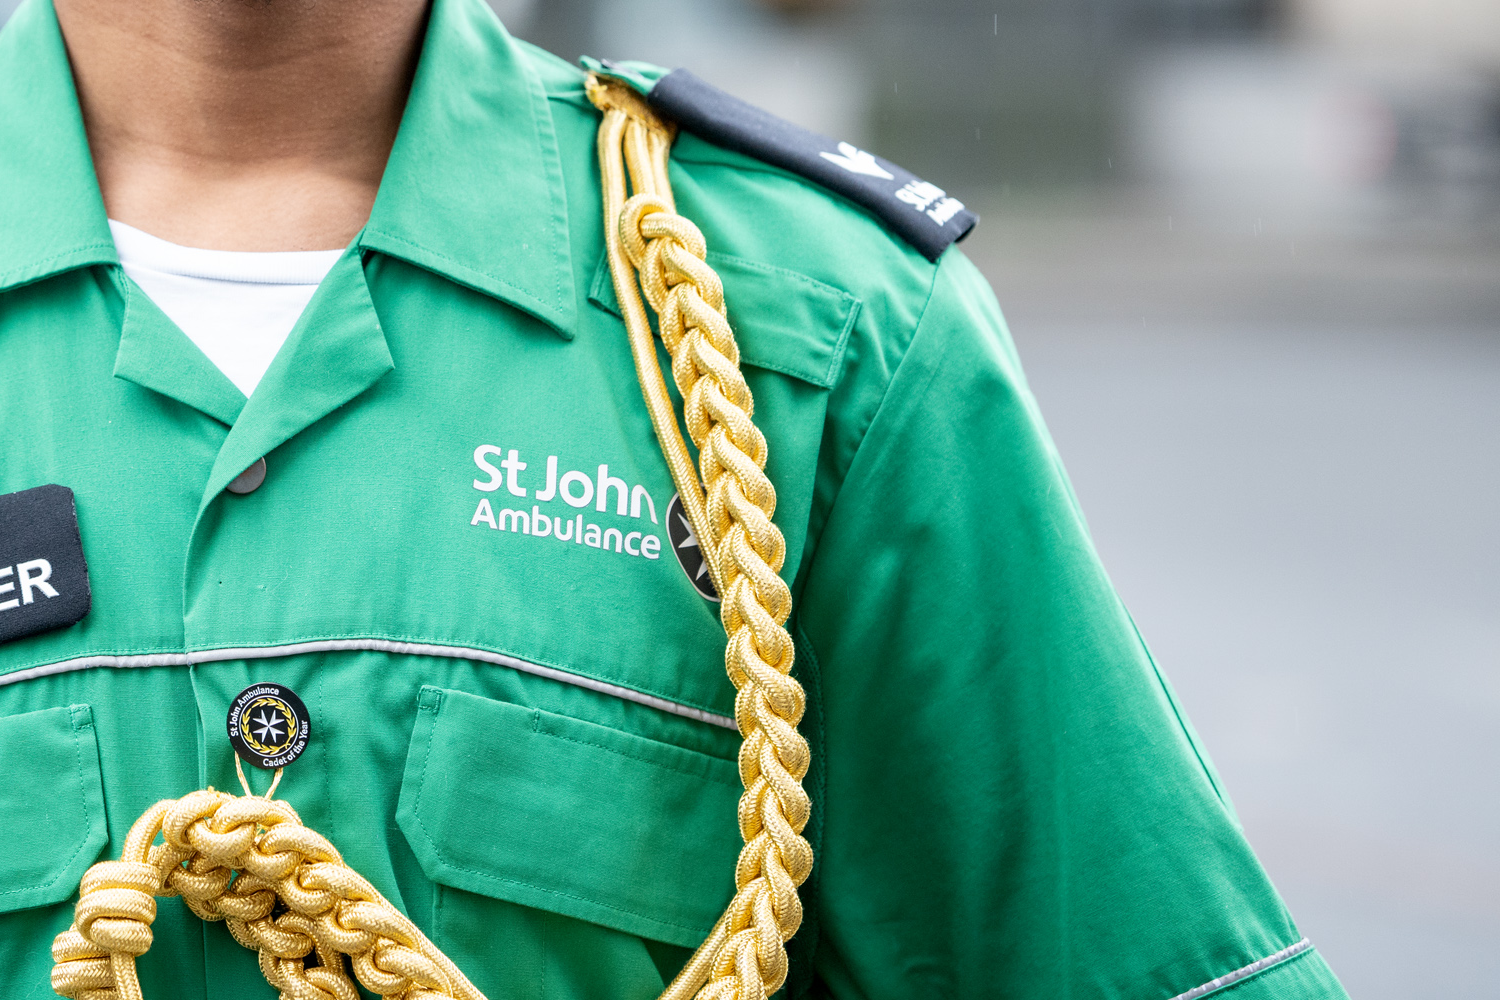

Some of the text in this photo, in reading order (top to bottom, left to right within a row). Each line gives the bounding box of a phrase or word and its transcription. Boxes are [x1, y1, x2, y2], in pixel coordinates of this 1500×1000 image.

[473, 444, 659, 525] St John
[470, 498, 661, 559] Ambulance
[230, 687, 280, 737] St John Ambulance
[262, 720, 309, 767] Cadet of the Year
